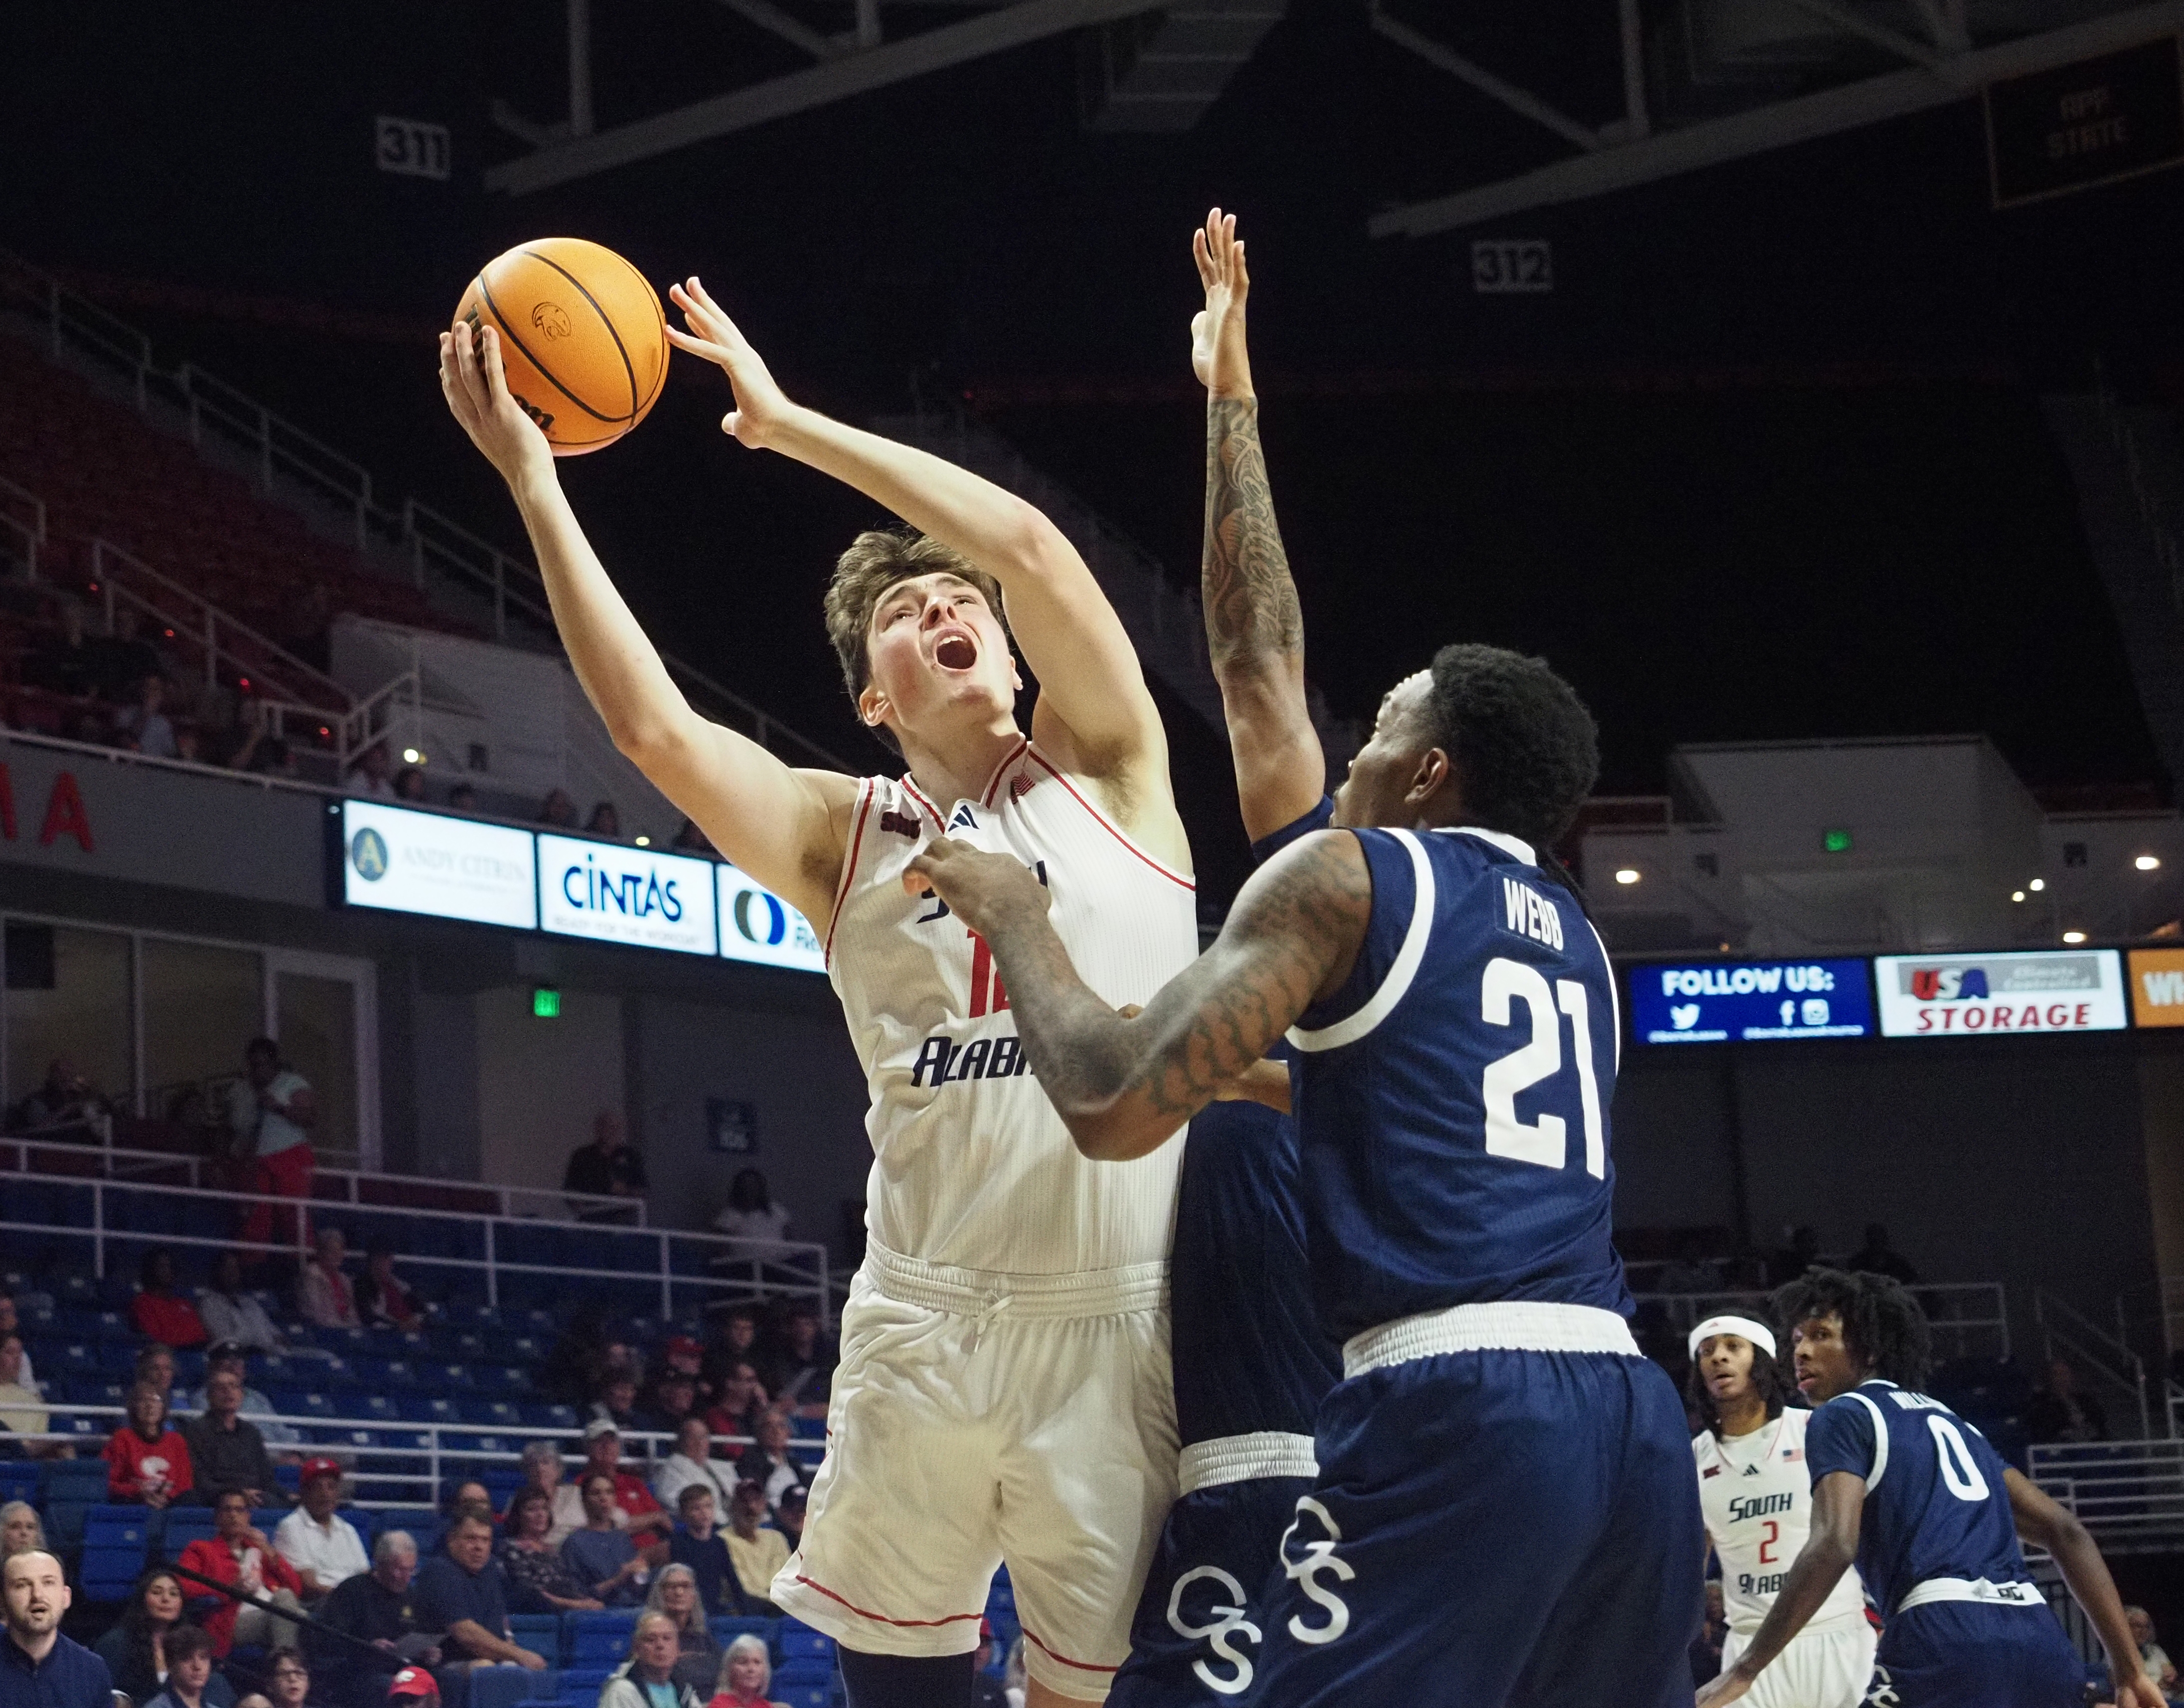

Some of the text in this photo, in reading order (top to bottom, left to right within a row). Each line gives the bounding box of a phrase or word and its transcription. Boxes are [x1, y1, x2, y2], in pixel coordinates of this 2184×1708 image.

[384, 125, 444, 170] 311
[2046, 114, 2130, 159] STATE
[1477, 249, 1546, 284] 312
[1503, 877, 1564, 951] WEBB
[1662, 965, 1836, 997] FOLLOW US:
[1911, 968, 1989, 1000] USA
[1916, 1003, 2092, 1031] STORAGE
[1482, 957, 1605, 1180] 21
[1926, 1415, 1990, 1501] 0
[1728, 1492, 1793, 1524] SOUTH
[1759, 1520, 1778, 1564] 2
